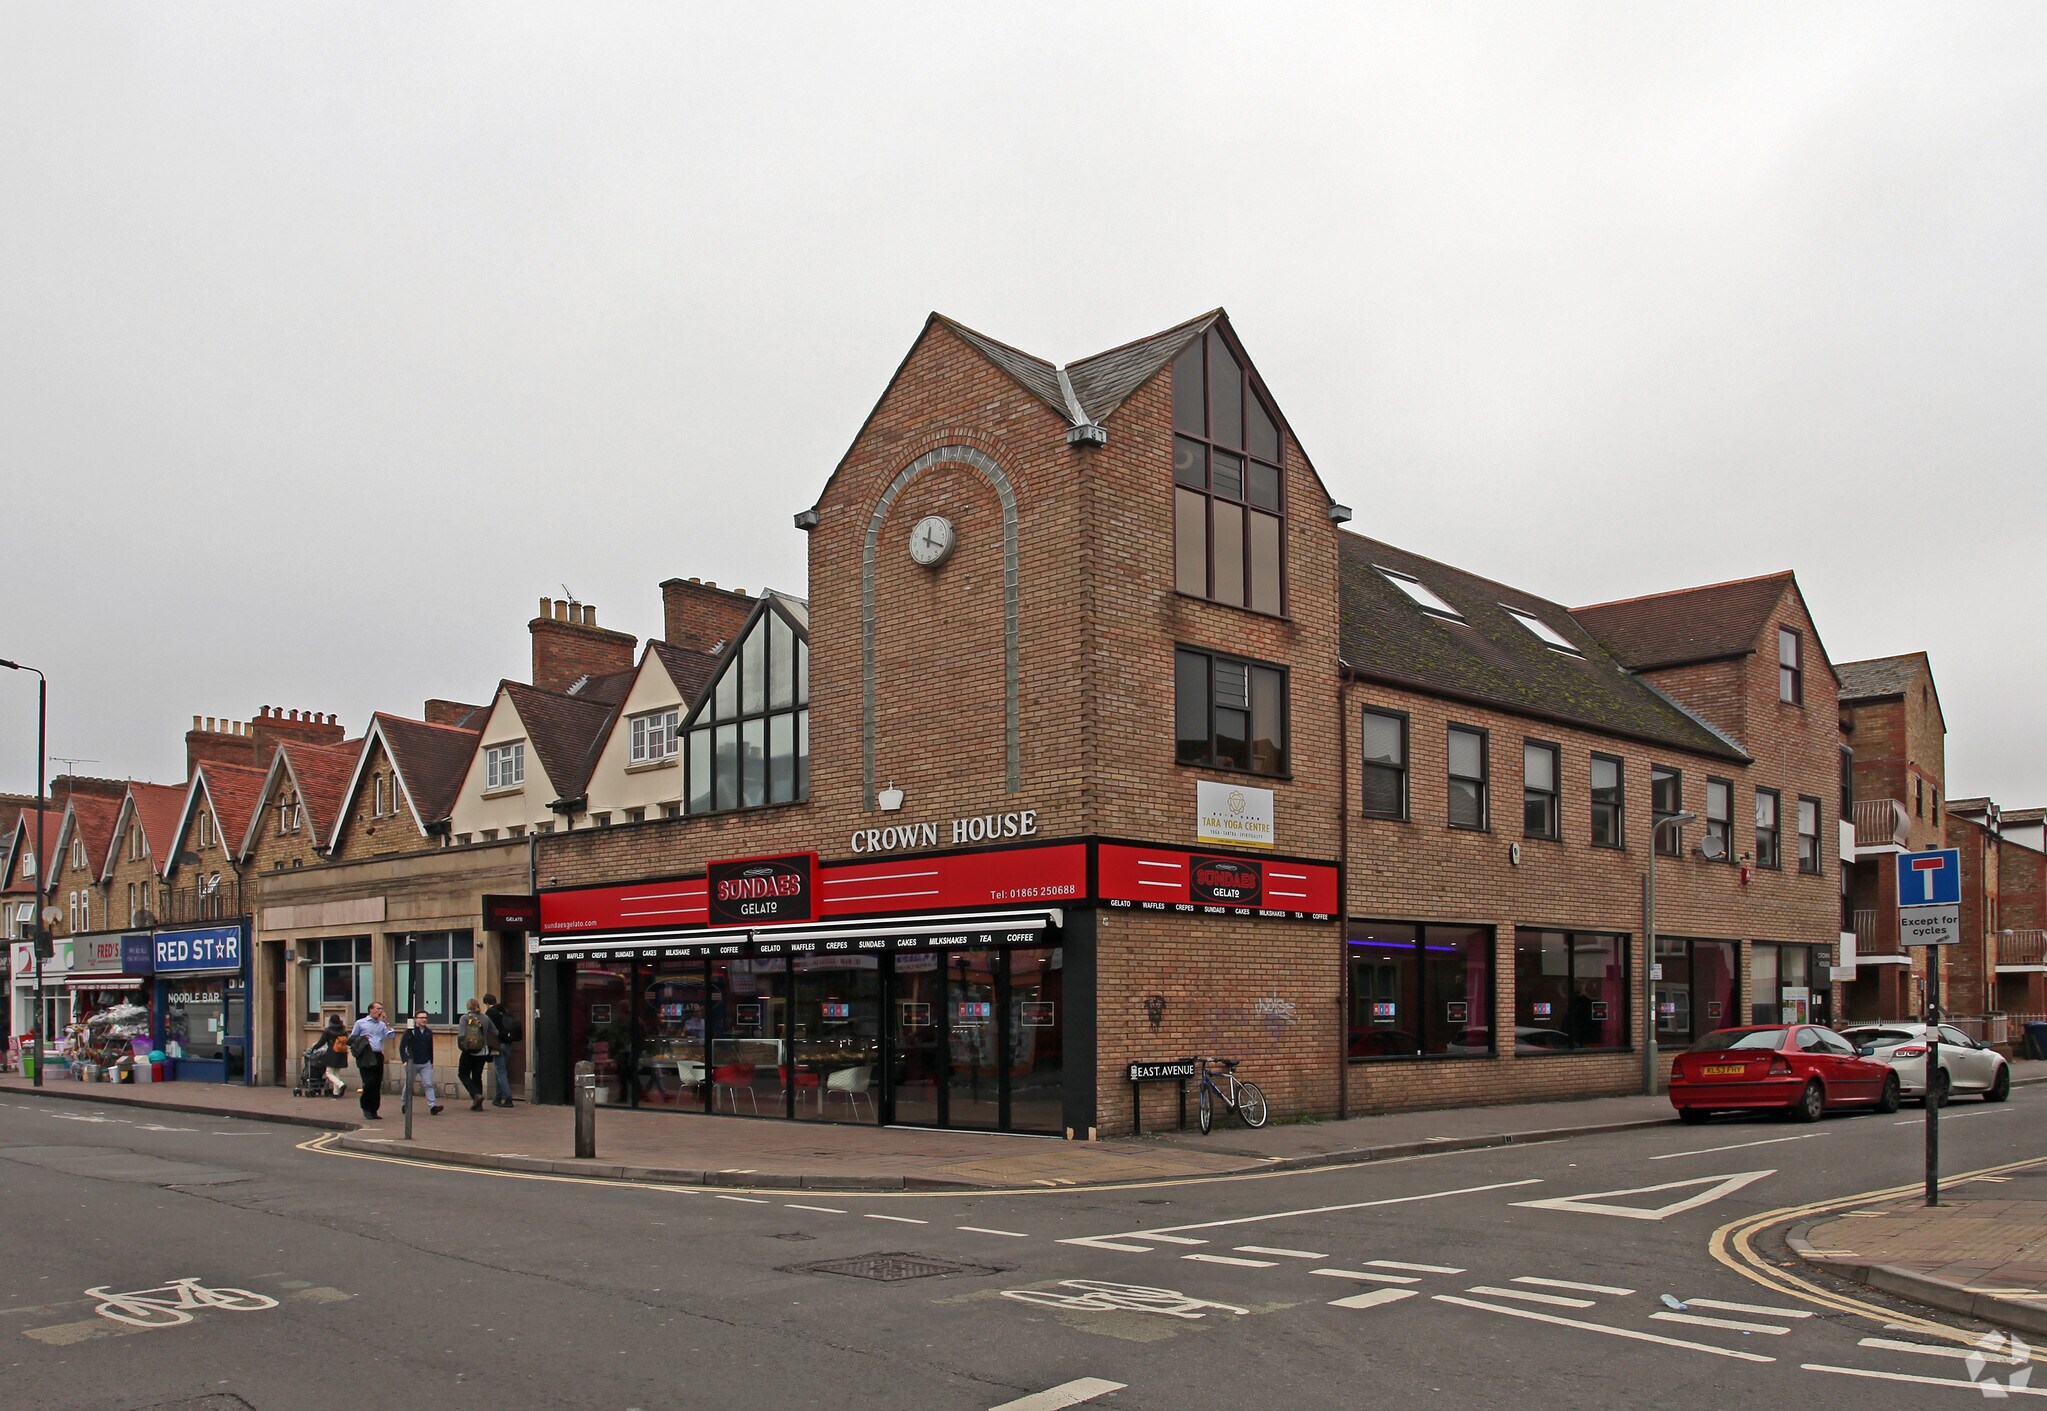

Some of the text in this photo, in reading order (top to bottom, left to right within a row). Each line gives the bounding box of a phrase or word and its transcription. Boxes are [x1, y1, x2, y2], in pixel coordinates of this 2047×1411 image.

[851, 809, 1038, 853] CROWN HOUSE
[1202, 817, 1270, 833] TARA YOGA CENTRE
[1196, 868, 1256, 889] SUNDAES
[717, 873, 801, 901] SUNDAES
[990, 884, 1076, 900] Tel: 01865 250688
[1213, 887, 1240, 899] GELATO
[740, 901, 778, 915] GELATO
[1110, 899, 1329, 921] GELATO WAFFLES CREPES SUNDAES CAKES MILKSHAKES TEA COFFEE
[544, 920, 598, 930] sundaesgelato.com
[1901, 916, 1958, 926] Except for
[1913, 926, 1947, 936] cycles
[97, 943, 119, 958] FRED'S
[760, 933, 1034, 953] GELATO WAFFLES CREPES SUNDAES CAKES MILKSHAKES TEA COFFEE
[156, 941, 189, 962] RED
[543, 946, 739, 961] GELATO WAFFLES CREPES SUNDAES CAKES MILKSHAKE TEA COFFEE
[168, 992, 220, 1003] NOODLE BAR
[1162, 1064, 1195, 1076] AVENUE
